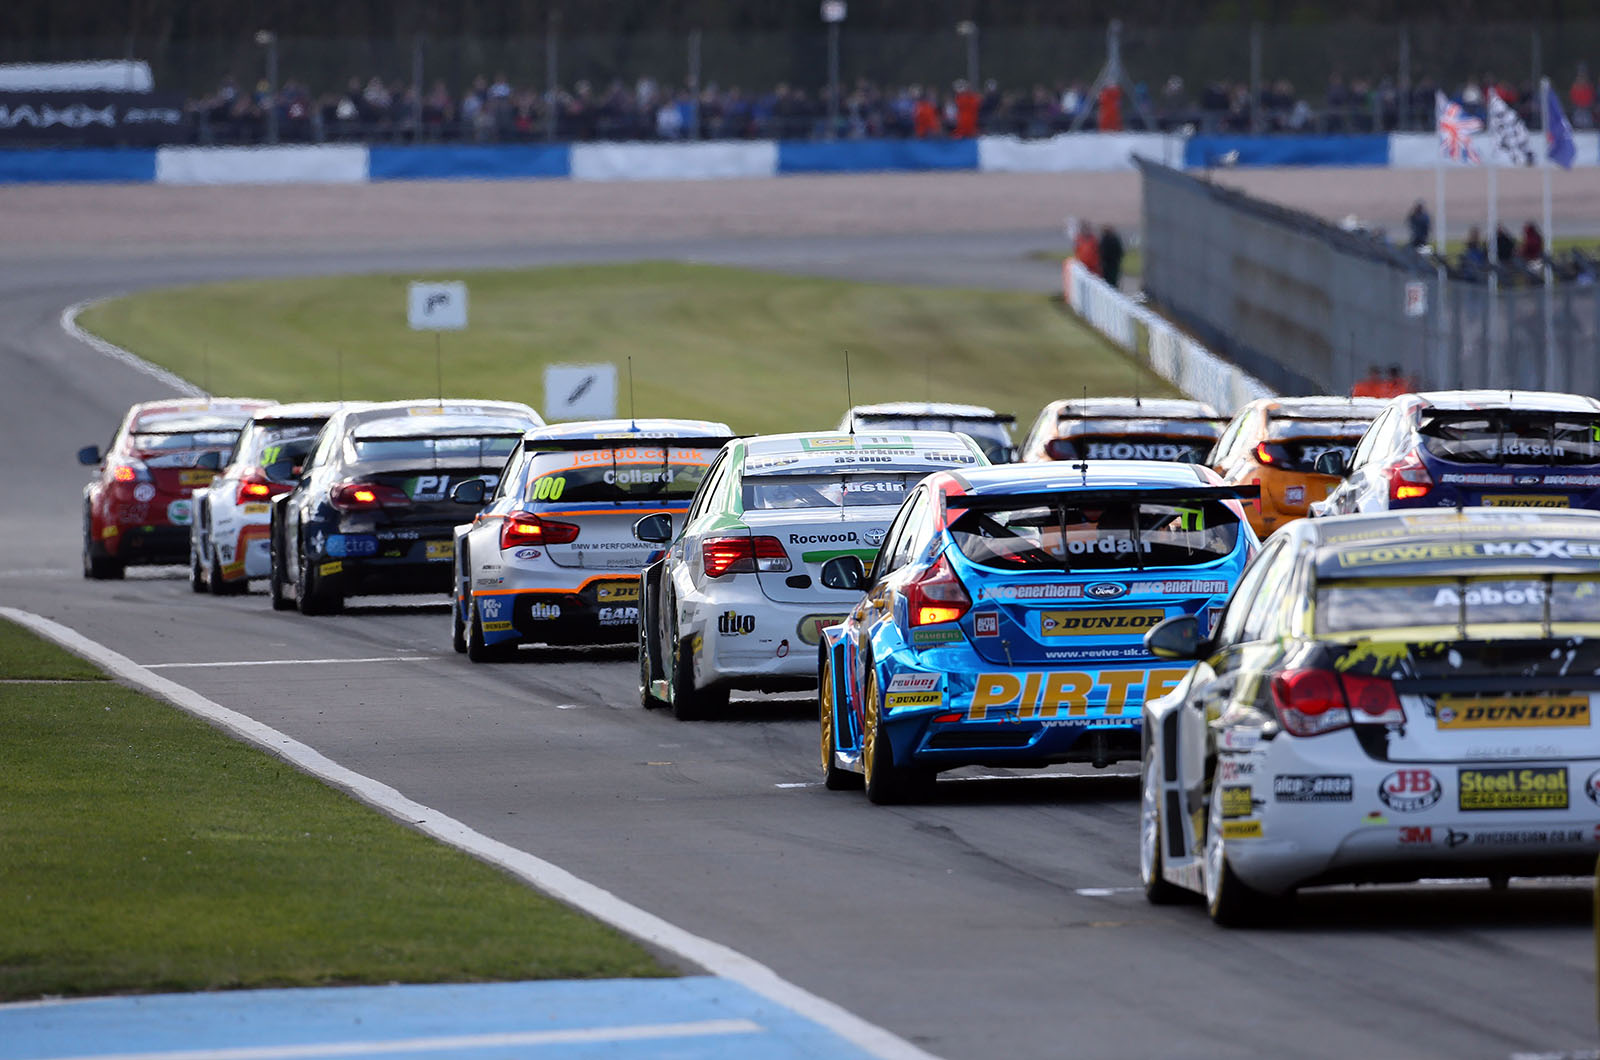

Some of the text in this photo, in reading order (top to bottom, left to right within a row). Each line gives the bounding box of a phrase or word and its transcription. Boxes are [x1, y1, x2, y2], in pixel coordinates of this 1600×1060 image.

[573, 448, 704, 466] jct600.co.uk
[603, 470, 674, 484] Collard
[532, 477, 566, 500] 100
[1051, 535, 1152, 554] Jordan
[718, 611, 755, 634] duo
[1062, 614, 1164, 631] DUNLOP
[1463, 705, 1588, 721] DUNLOP
[1461, 772, 1516, 791] Steel
[1520, 770, 1567, 790] Seal
[1399, 827, 1432, 843] 3M
